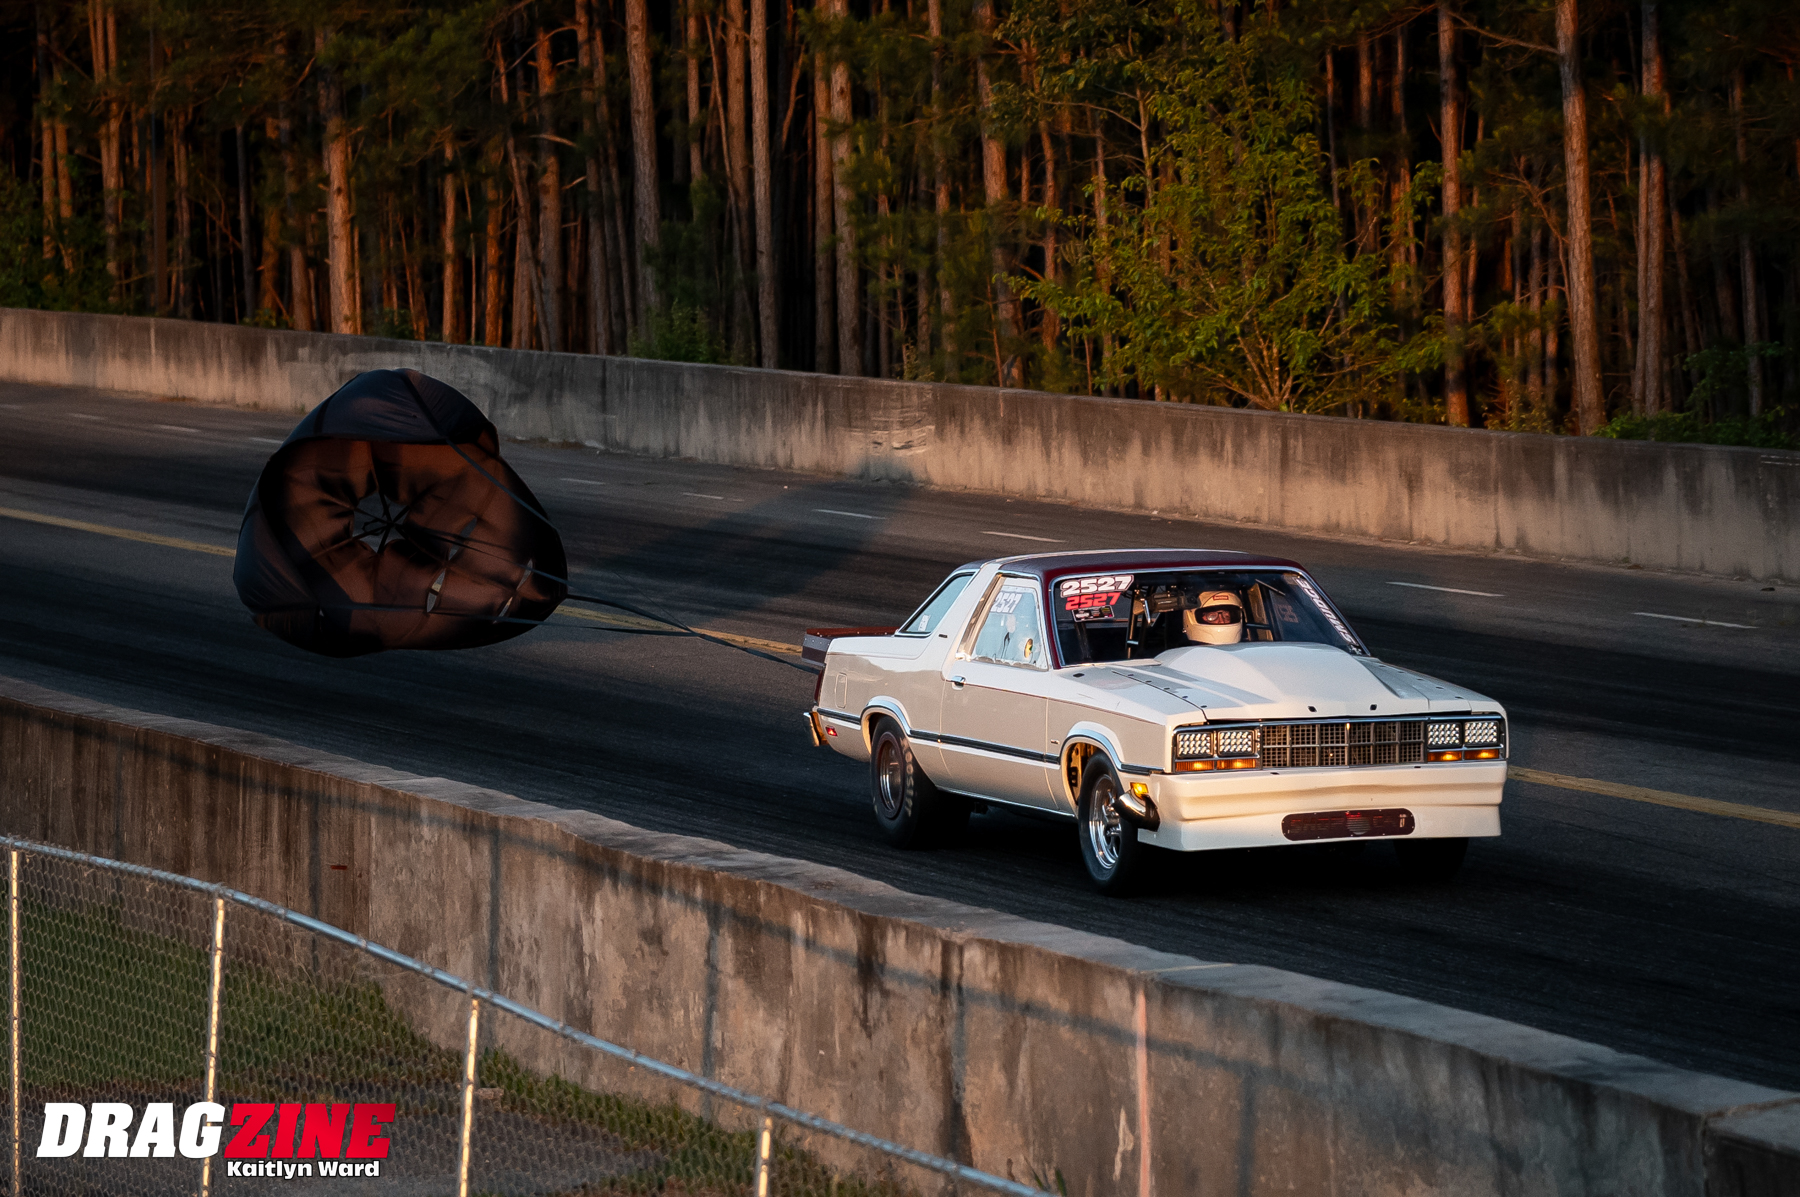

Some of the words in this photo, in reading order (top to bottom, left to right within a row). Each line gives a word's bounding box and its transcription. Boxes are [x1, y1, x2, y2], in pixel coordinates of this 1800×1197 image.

[1061, 575, 1133, 597] 2527
[990, 591, 1022, 613] 2527
[1065, 592, 1121, 610] 2527
[1294, 577, 1358, 646] SMUDGE
